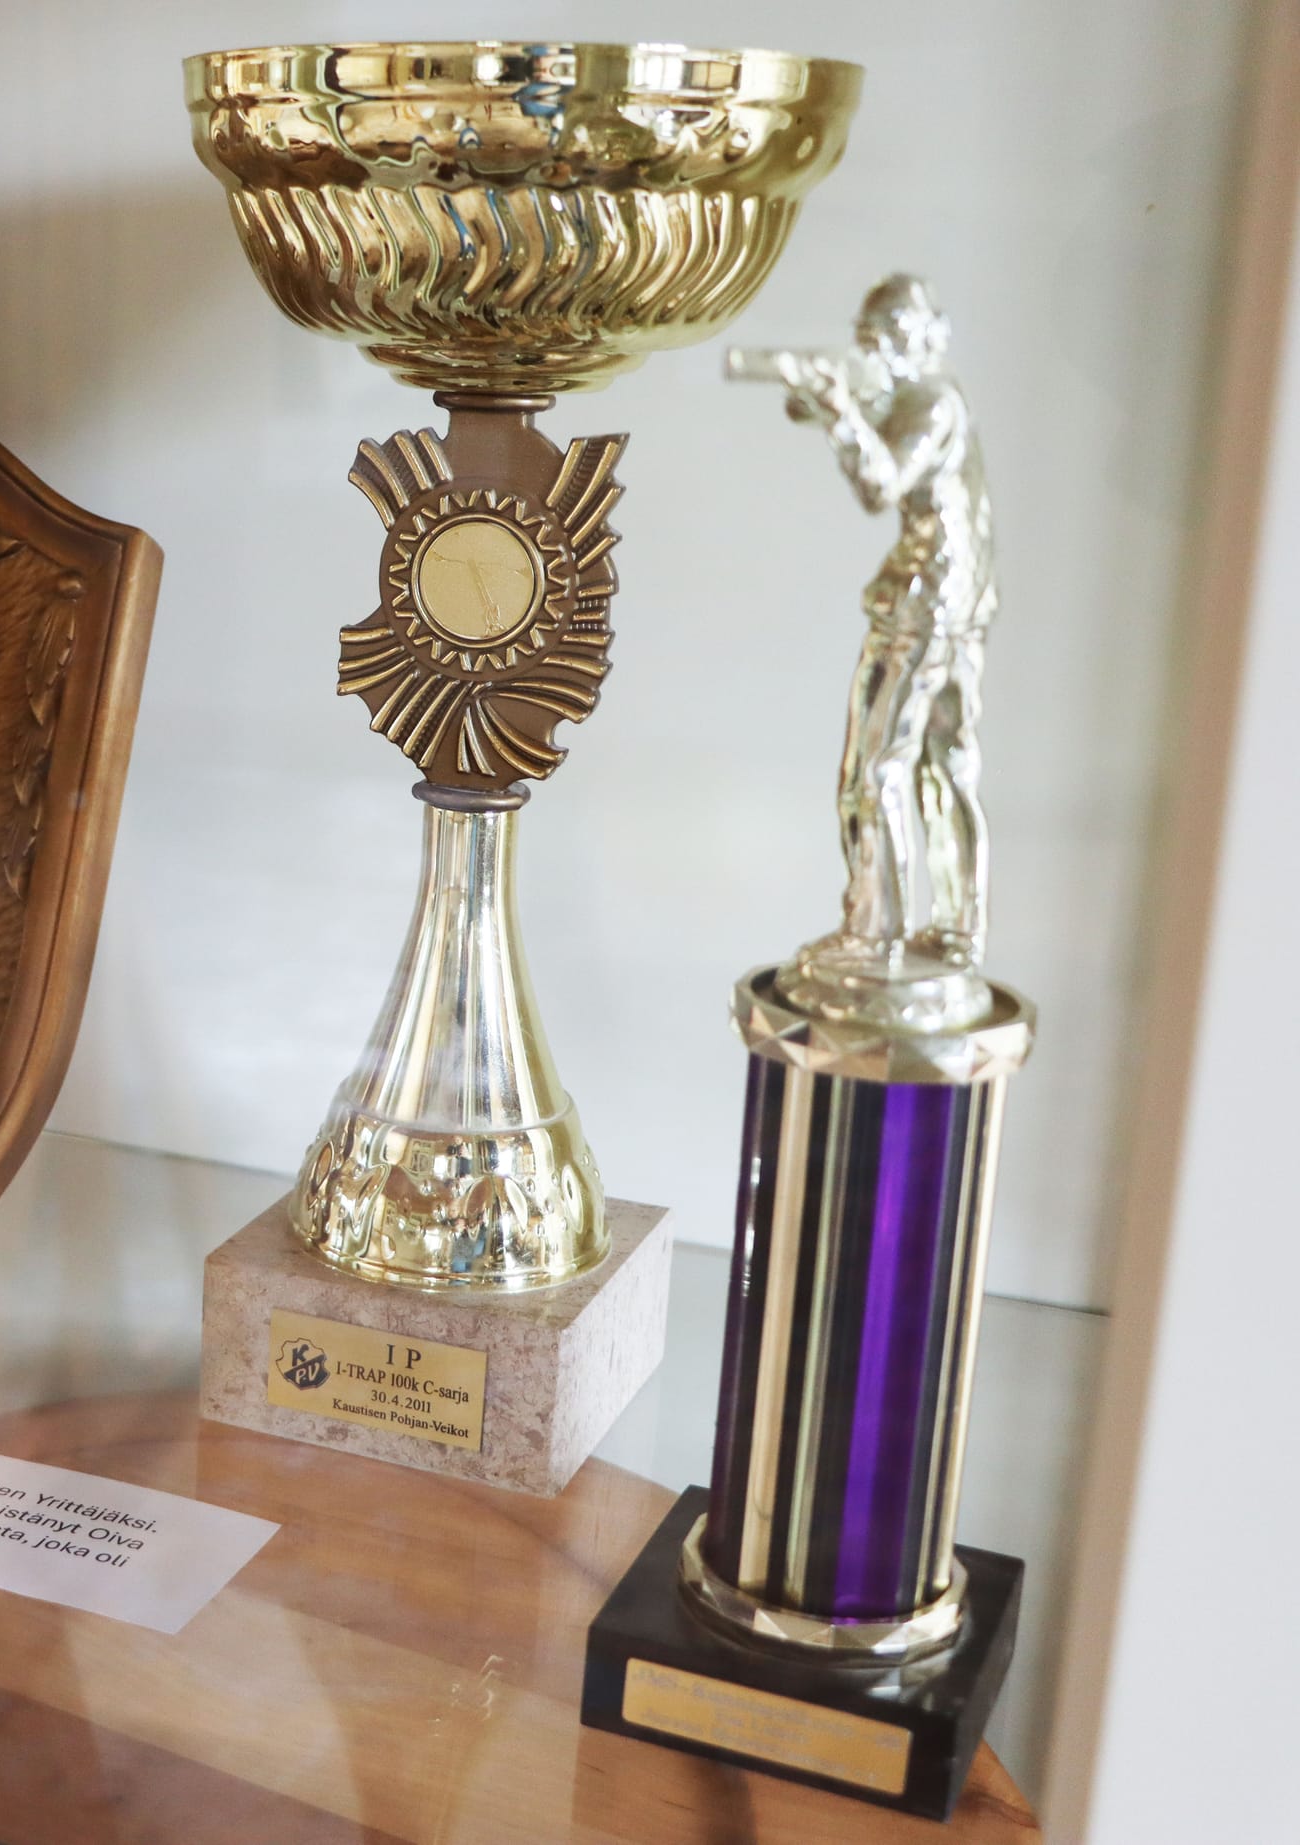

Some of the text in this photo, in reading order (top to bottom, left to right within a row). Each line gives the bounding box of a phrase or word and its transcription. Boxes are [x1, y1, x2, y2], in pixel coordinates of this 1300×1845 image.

[405, 1347, 422, 1370] P
[391, 1373, 420, 1392] 100k
[423, 1380, 469, 1404] C-sarja
[332, 1398, 469, 1439] Kaustisen Pohjan-Veikot
[36, 1493, 158, 1533] Yrittäjäksi.
[32, 1535, 90, 1558] joka
[95, 1551, 131, 1568] oli
[88, 1527, 145, 1551] Oiva
